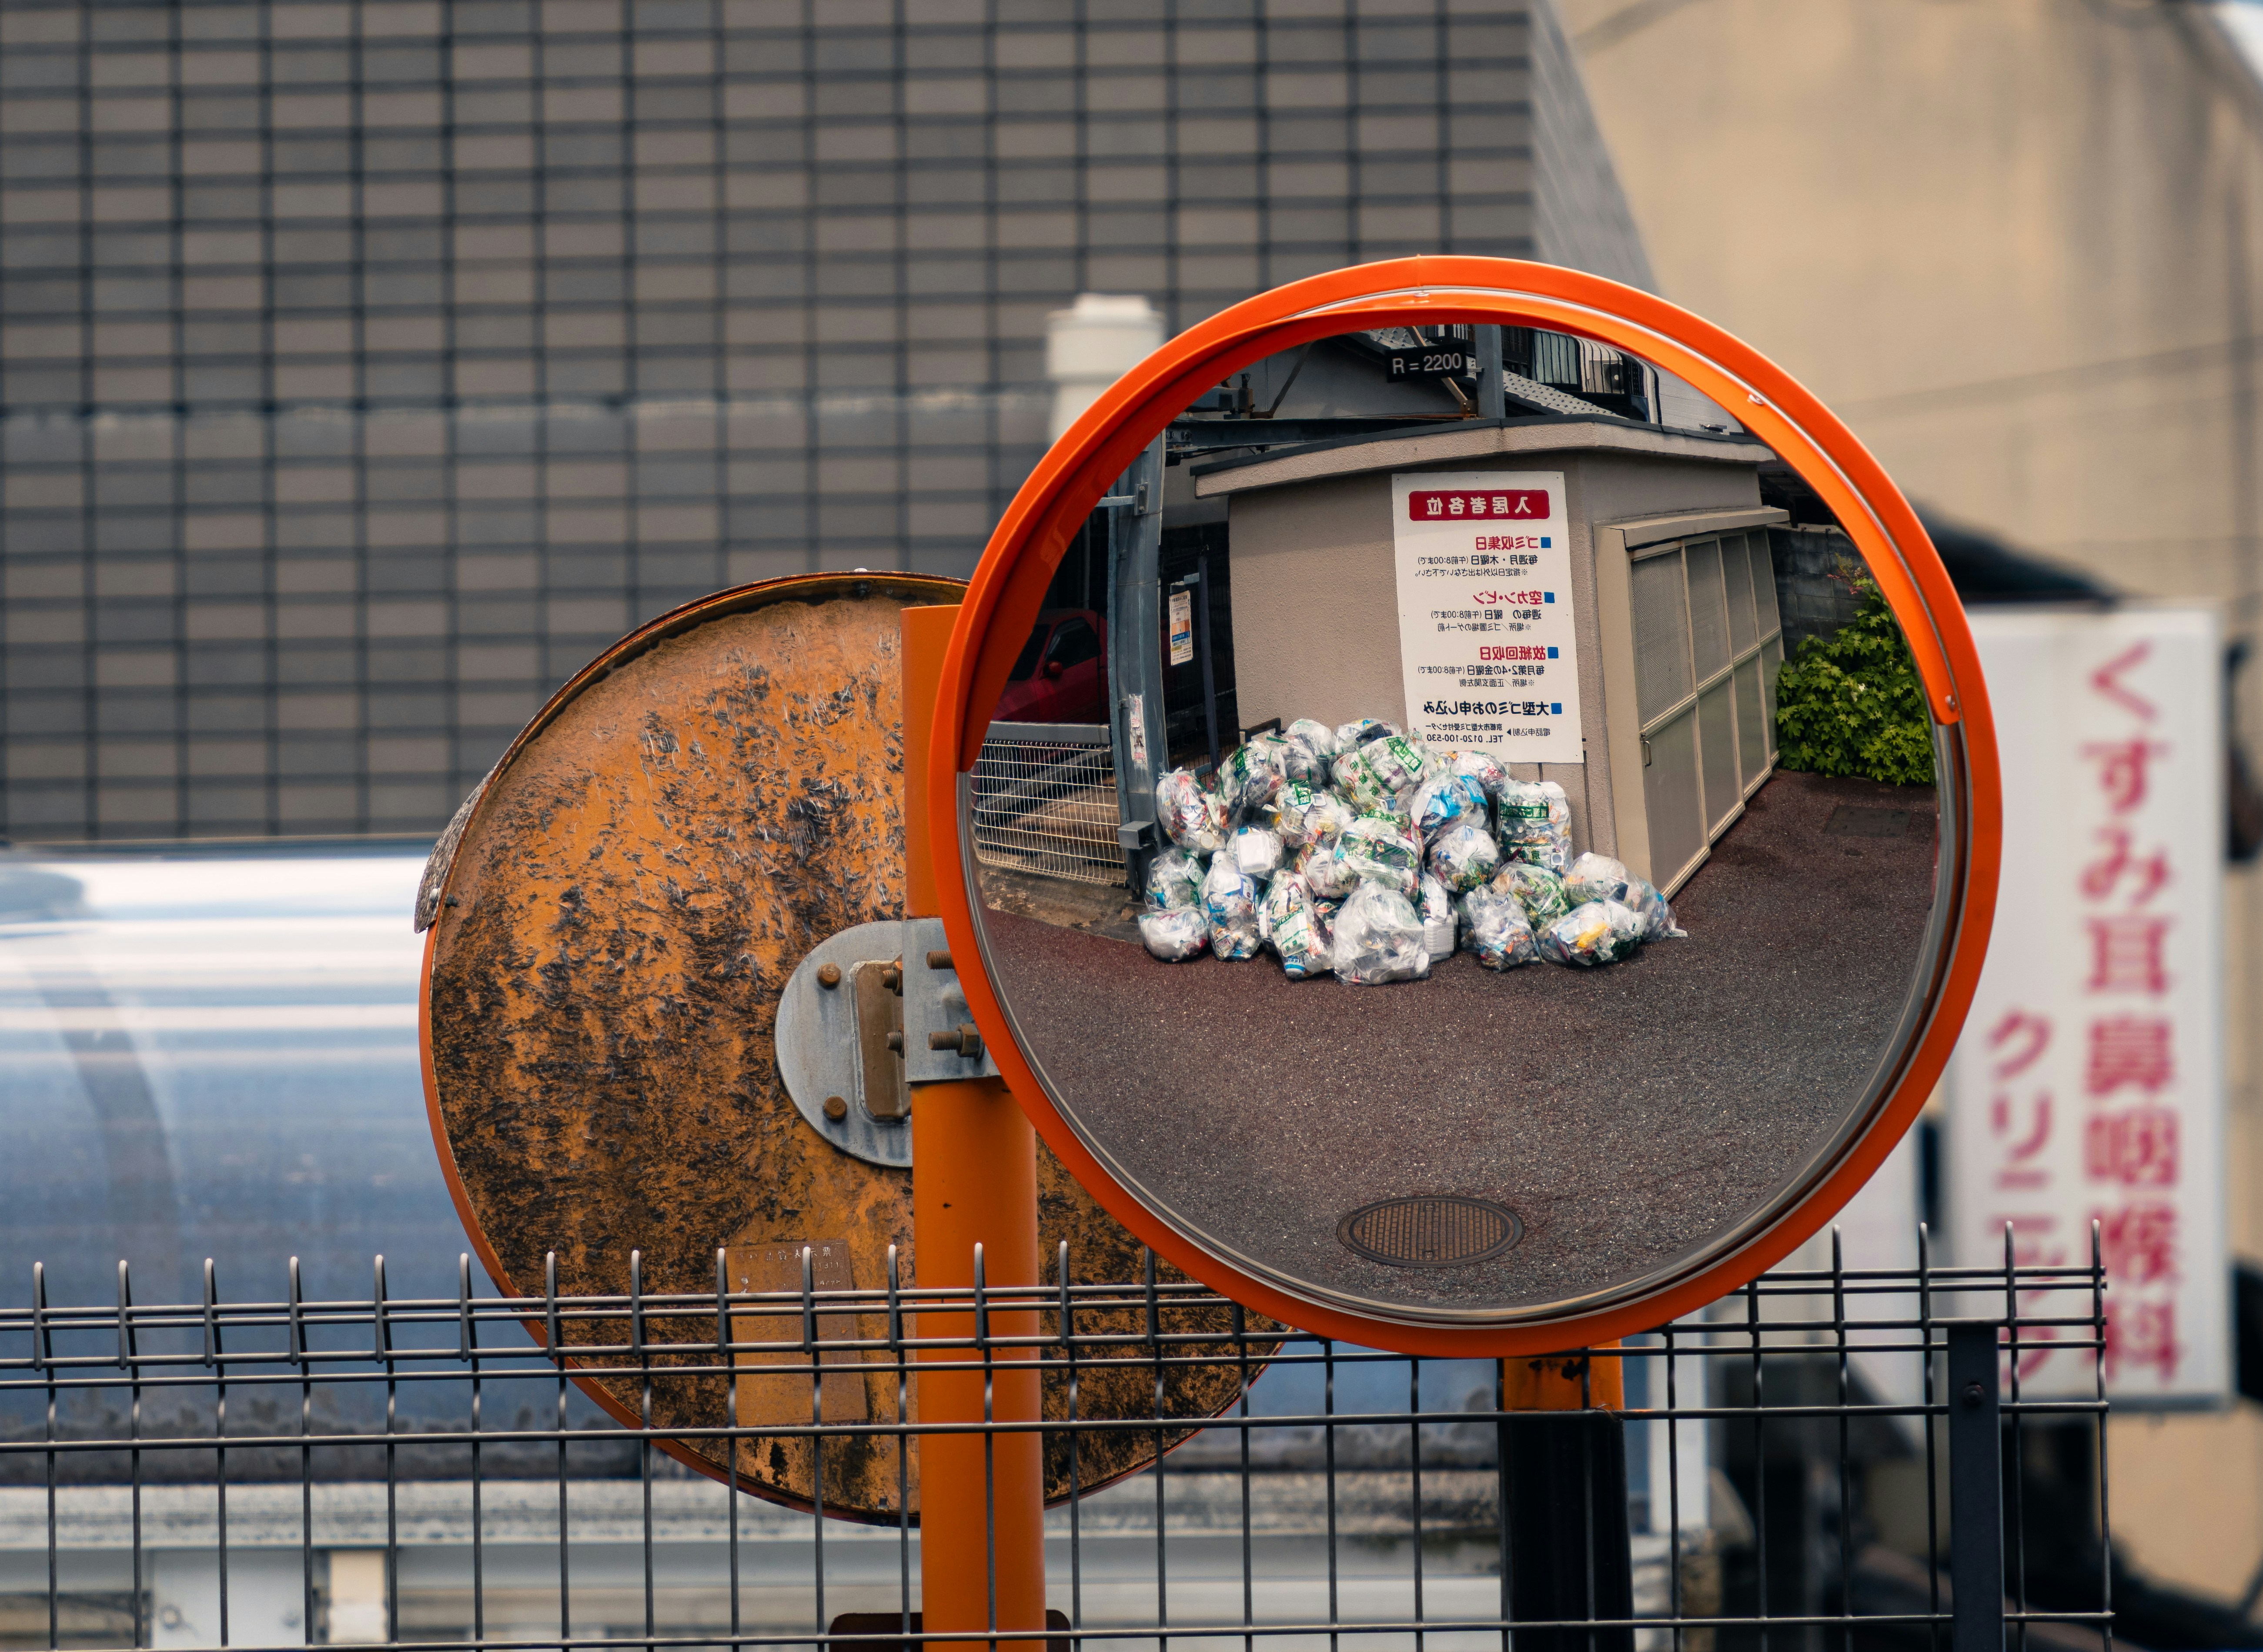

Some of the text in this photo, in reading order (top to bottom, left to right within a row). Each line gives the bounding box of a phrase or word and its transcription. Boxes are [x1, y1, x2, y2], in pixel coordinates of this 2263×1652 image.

[1392, 358, 1405, 374] R
[1424, 353, 1462, 371] 2200
[2078, 636, 2182, 1384] くすみ耳鼻咽喉科
